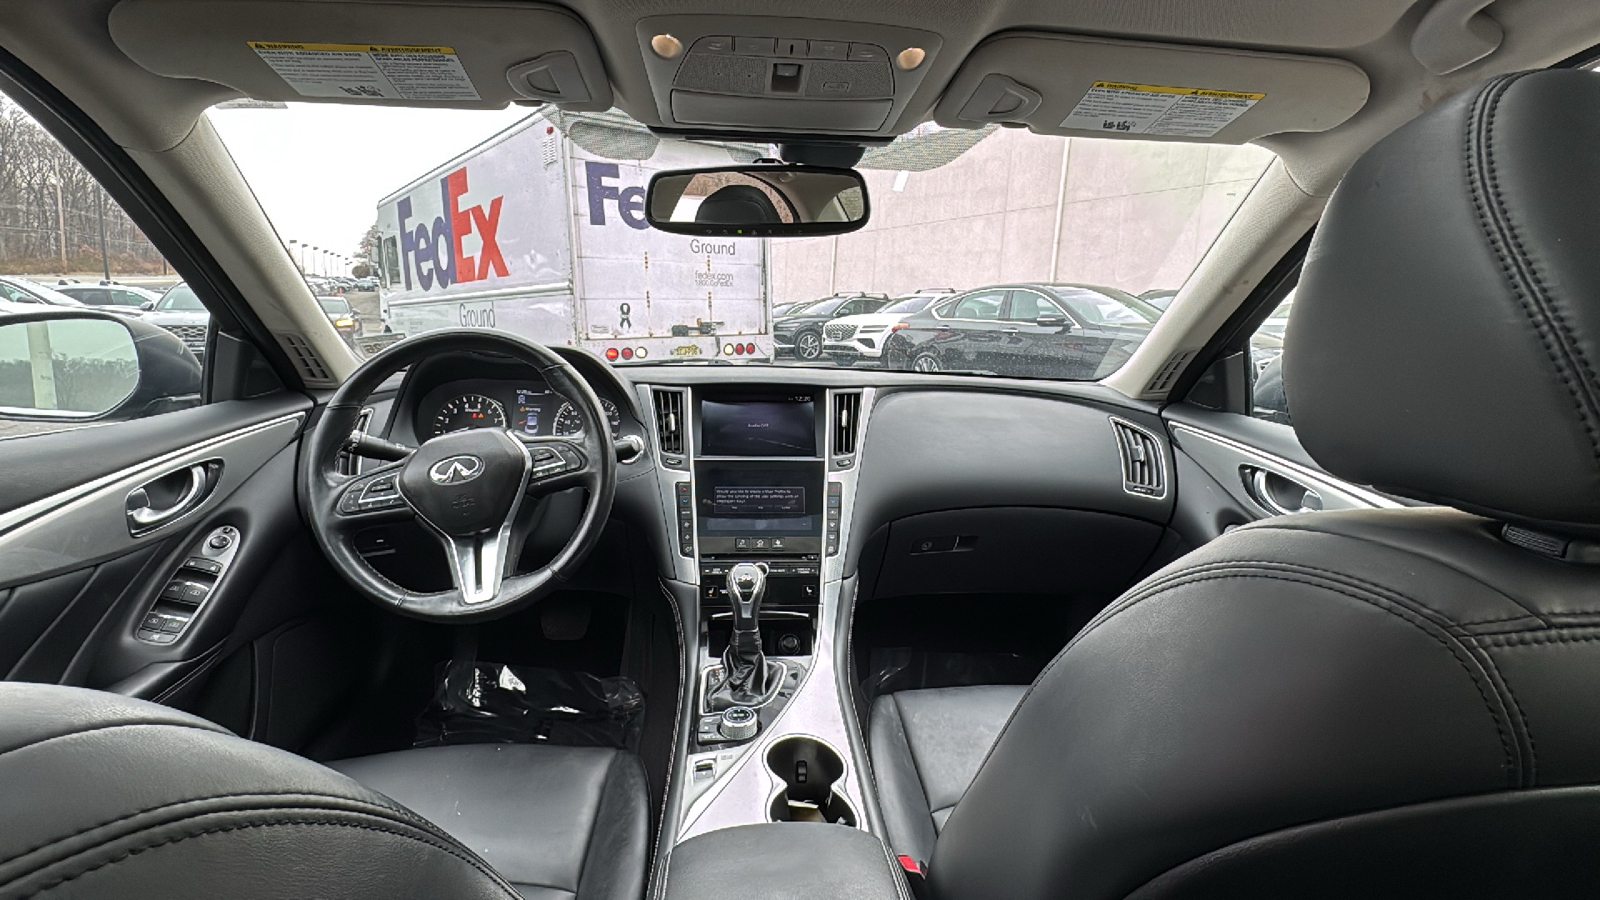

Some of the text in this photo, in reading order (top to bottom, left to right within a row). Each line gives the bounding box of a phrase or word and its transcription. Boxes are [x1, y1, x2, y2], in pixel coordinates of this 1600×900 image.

[585, 161, 650, 230] Fe
[397, 166, 510, 292] FedEx
[690, 238, 736, 256] Ground
[695, 270, 734, 281] fedex.com
[459, 301, 496, 328] Ground
